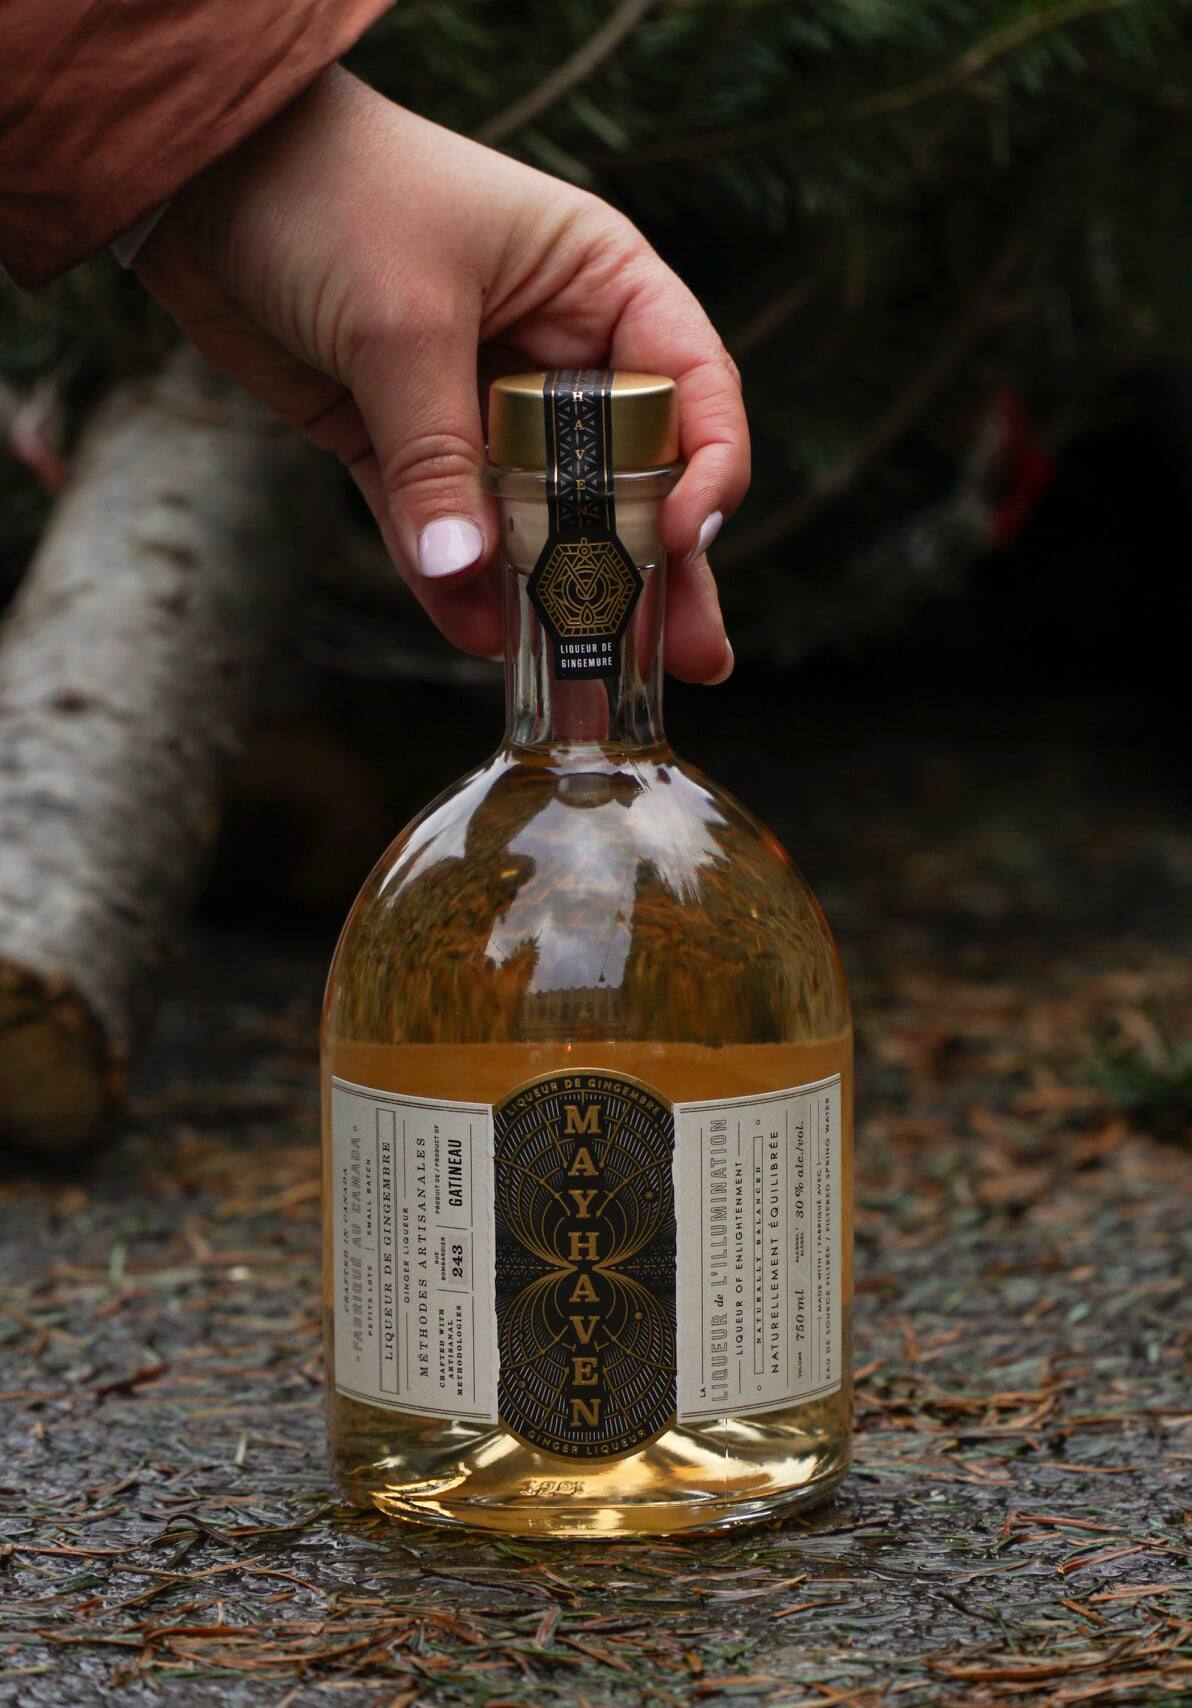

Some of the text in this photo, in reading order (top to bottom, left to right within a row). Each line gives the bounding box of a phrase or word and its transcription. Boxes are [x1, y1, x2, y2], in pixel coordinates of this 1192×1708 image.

[560, 642, 612, 654] LIQUEUR DE
[561, 656, 613, 669] GINGEMBRE
[507, 1078, 660, 1117] LIQUEUR DE GINGEMBRE
[434, 1125, 439, 1133] OF
[435, 1174, 440, 1182] DE
[448, 1139, 462, 1207] GATINEAU
[795, 1121, 804, 1218] 30 % alc./vol.
[735, 1161, 743, 1270] ENLIGHTENMENT
[343, 1228, 348, 1244] IN
[350, 1138, 362, 1352] FABRIQUÉ AU CANADA
[382, 1142, 394, 1360] LIQUEUR DE GINGEMBRE
[768, 1131, 779, 1373] NATURELLEMENT ÉQUILIBRÉE
[416, 1138, 428, 1377] MÉTHODES ARTISANALES
[452, 1245, 463, 1278] 243
[564, 1104, 602, 1428] MAYHAVEN
[715, 1294, 724, 1307] de
[736, 1277, 743, 1293] OF
[795, 1289, 804, 1341] 750 ml
[711, 1314, 728, 1402] LIQUEUR
[826, 1340, 830, 1353] DE
[700, 1388, 706, 1398] LA
[528, 1429, 645, 1456] GINGER LIQUEUR
